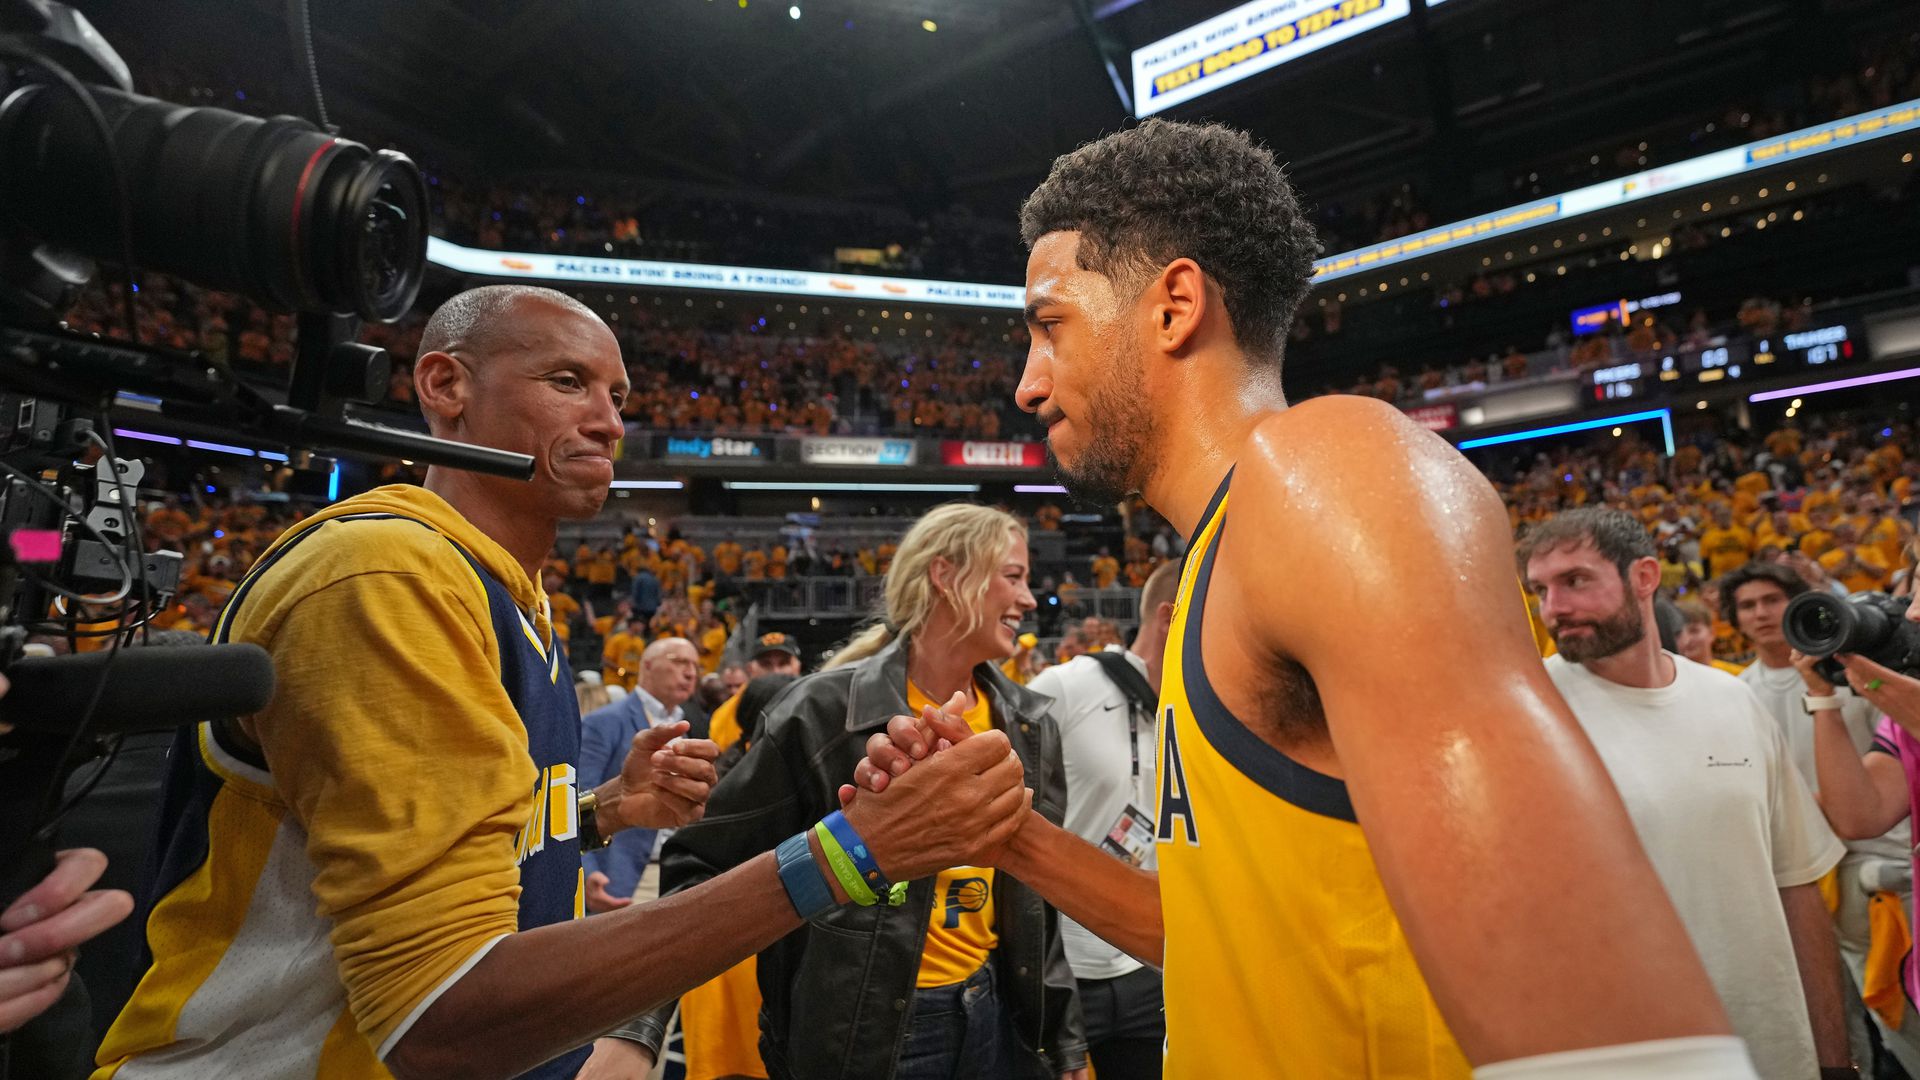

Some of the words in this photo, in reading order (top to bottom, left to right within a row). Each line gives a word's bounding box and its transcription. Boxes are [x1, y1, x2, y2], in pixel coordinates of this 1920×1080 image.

[1154, 61, 1201, 94] TEXT
[1264, 24, 1296, 50] TO
[804, 442, 878, 457] SECTION
